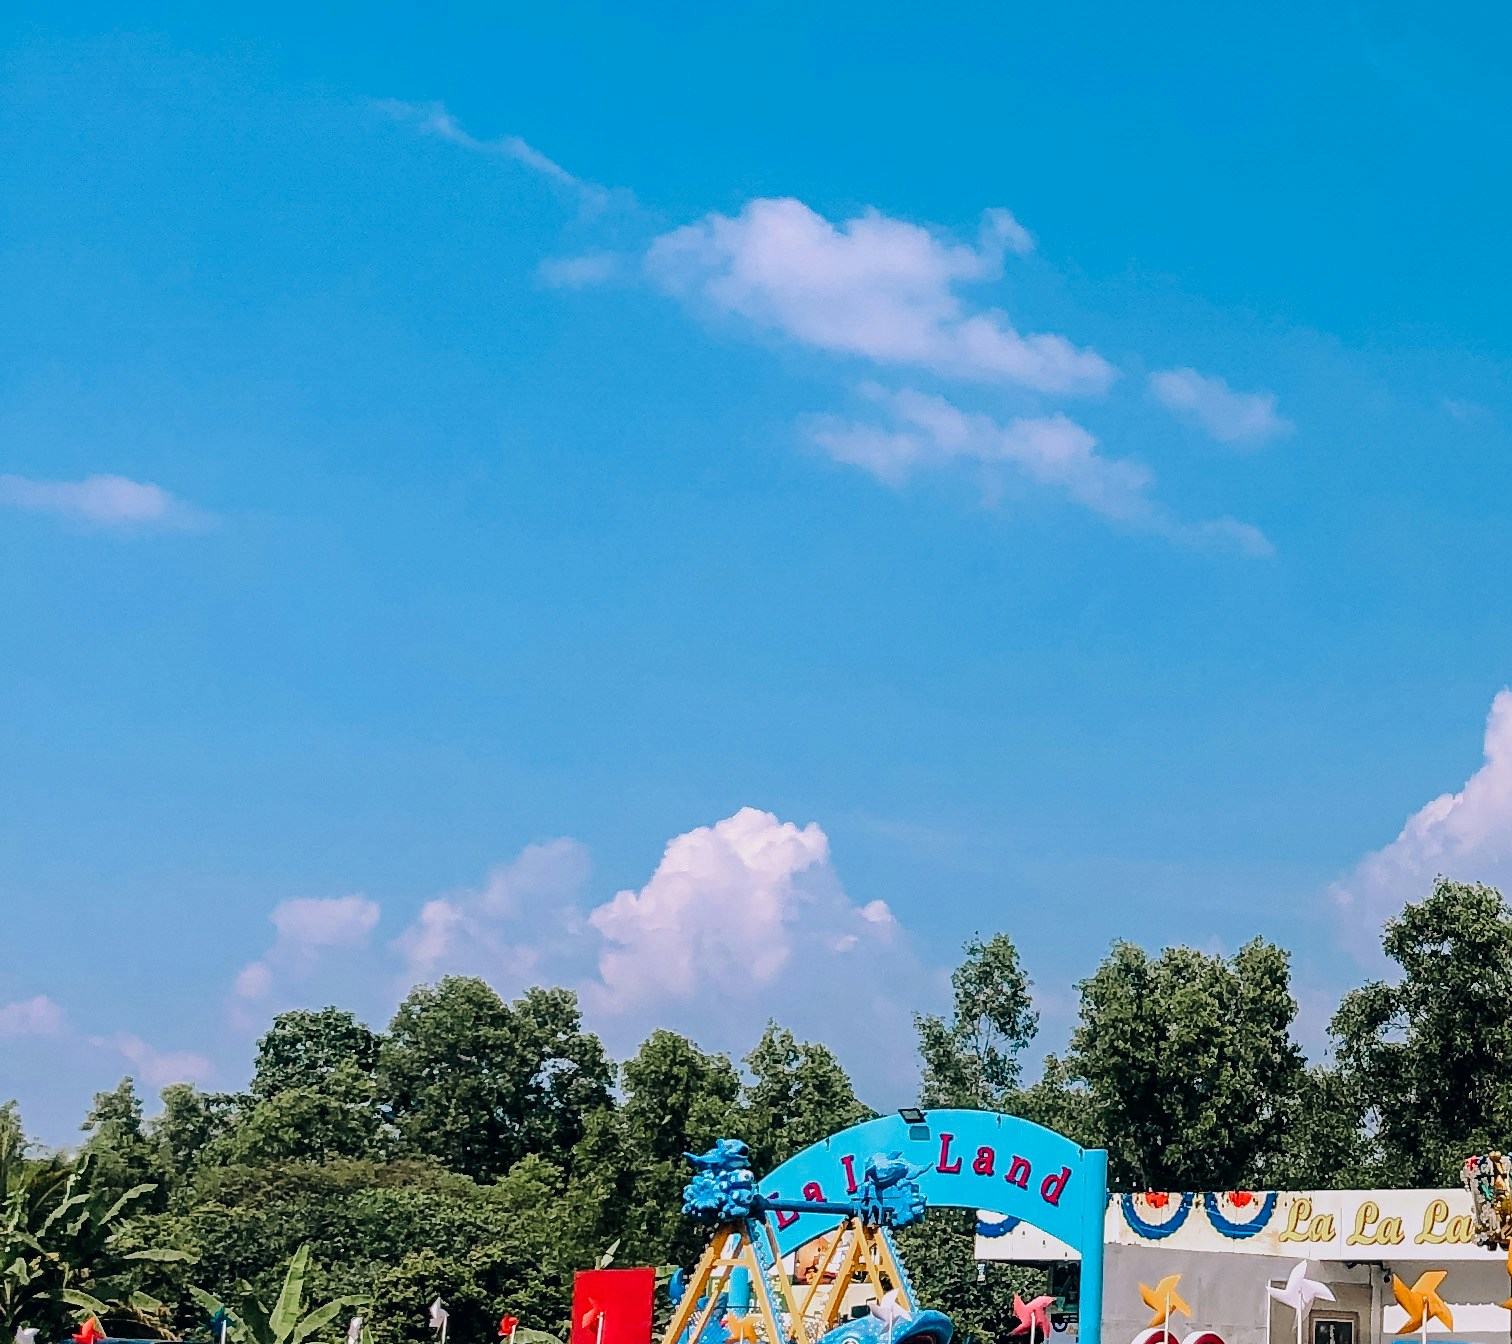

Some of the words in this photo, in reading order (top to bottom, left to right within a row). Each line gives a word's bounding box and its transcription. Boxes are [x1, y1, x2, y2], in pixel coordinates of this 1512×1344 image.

[936, 1133, 1072, 1207] Land
[1279, 1197, 1337, 1243] La
[1346, 1200, 1405, 1246] La
[1414, 1199, 1474, 1245] La
